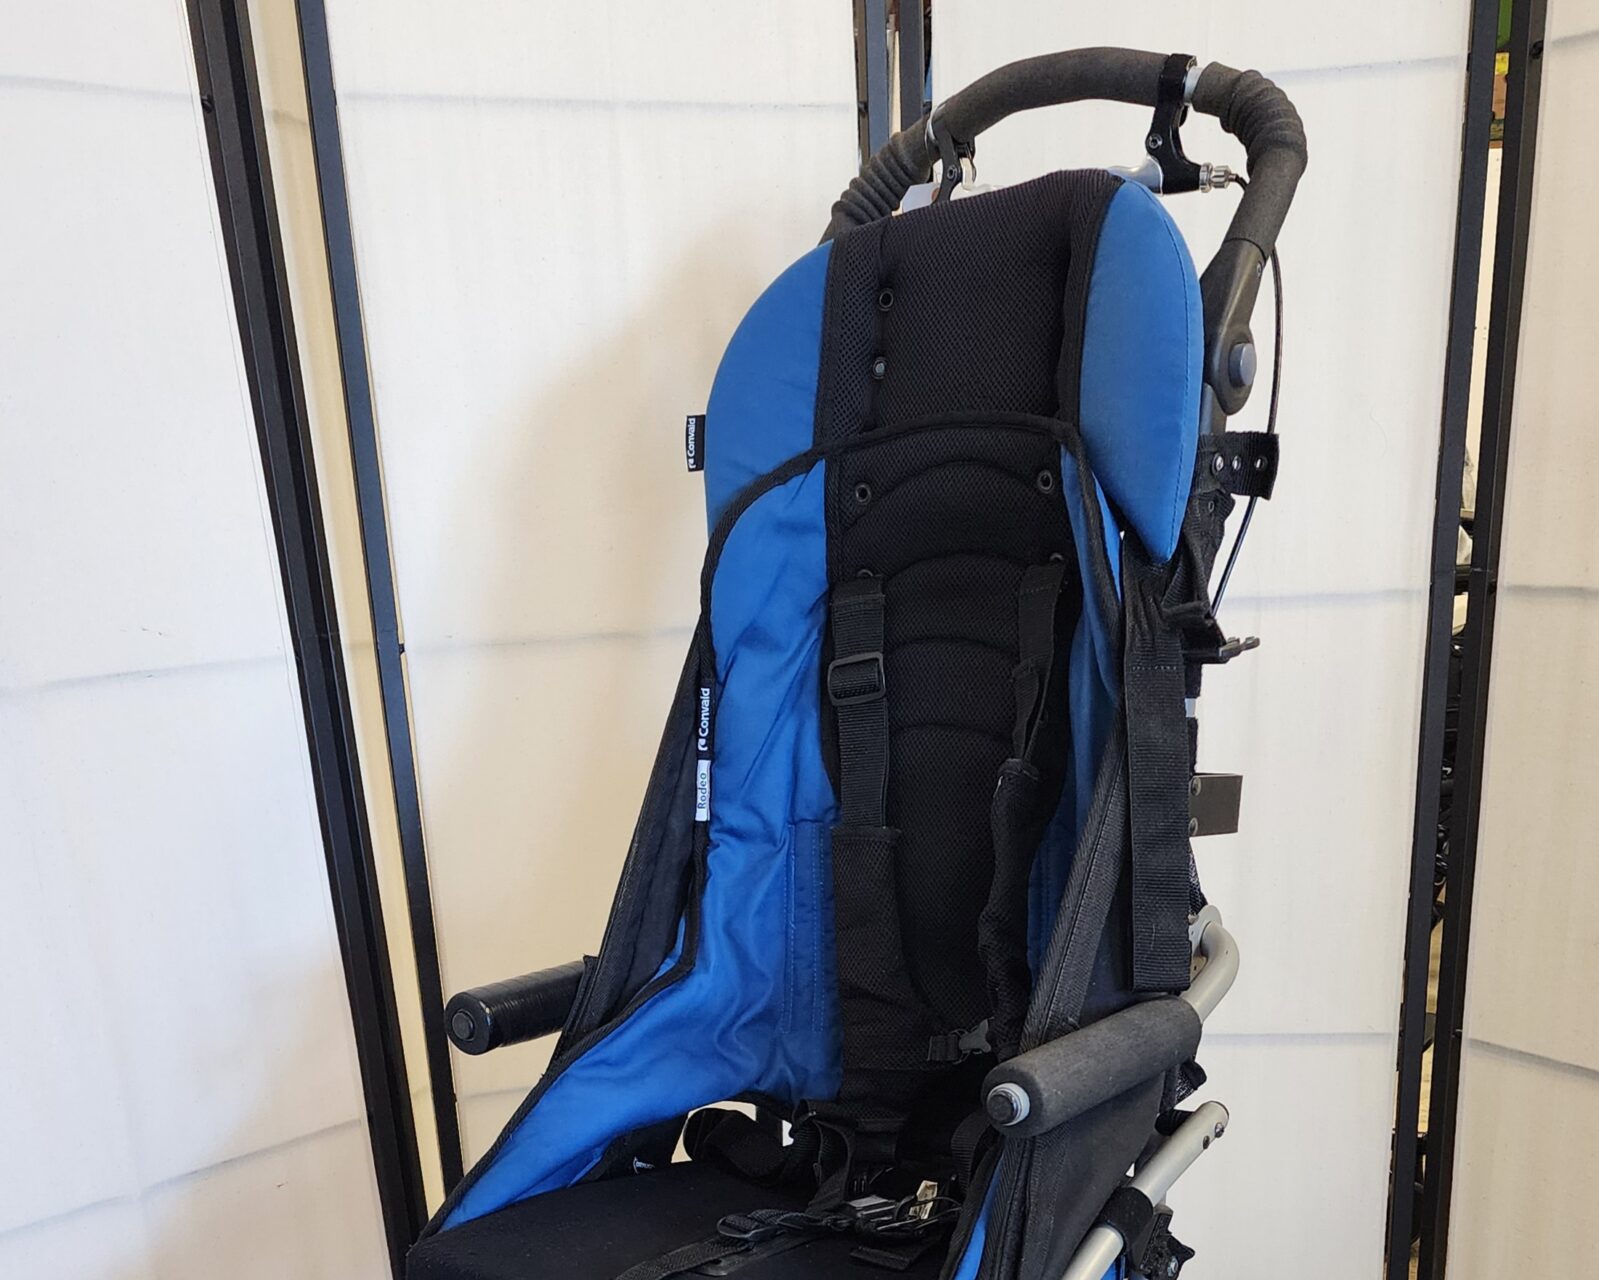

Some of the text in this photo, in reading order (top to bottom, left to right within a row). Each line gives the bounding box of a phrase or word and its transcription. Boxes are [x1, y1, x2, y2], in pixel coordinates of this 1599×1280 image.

[687, 417, 696, 458] Convaid
[699, 687, 711, 737] Convaid
[697, 772, 707, 810] Rodeo
